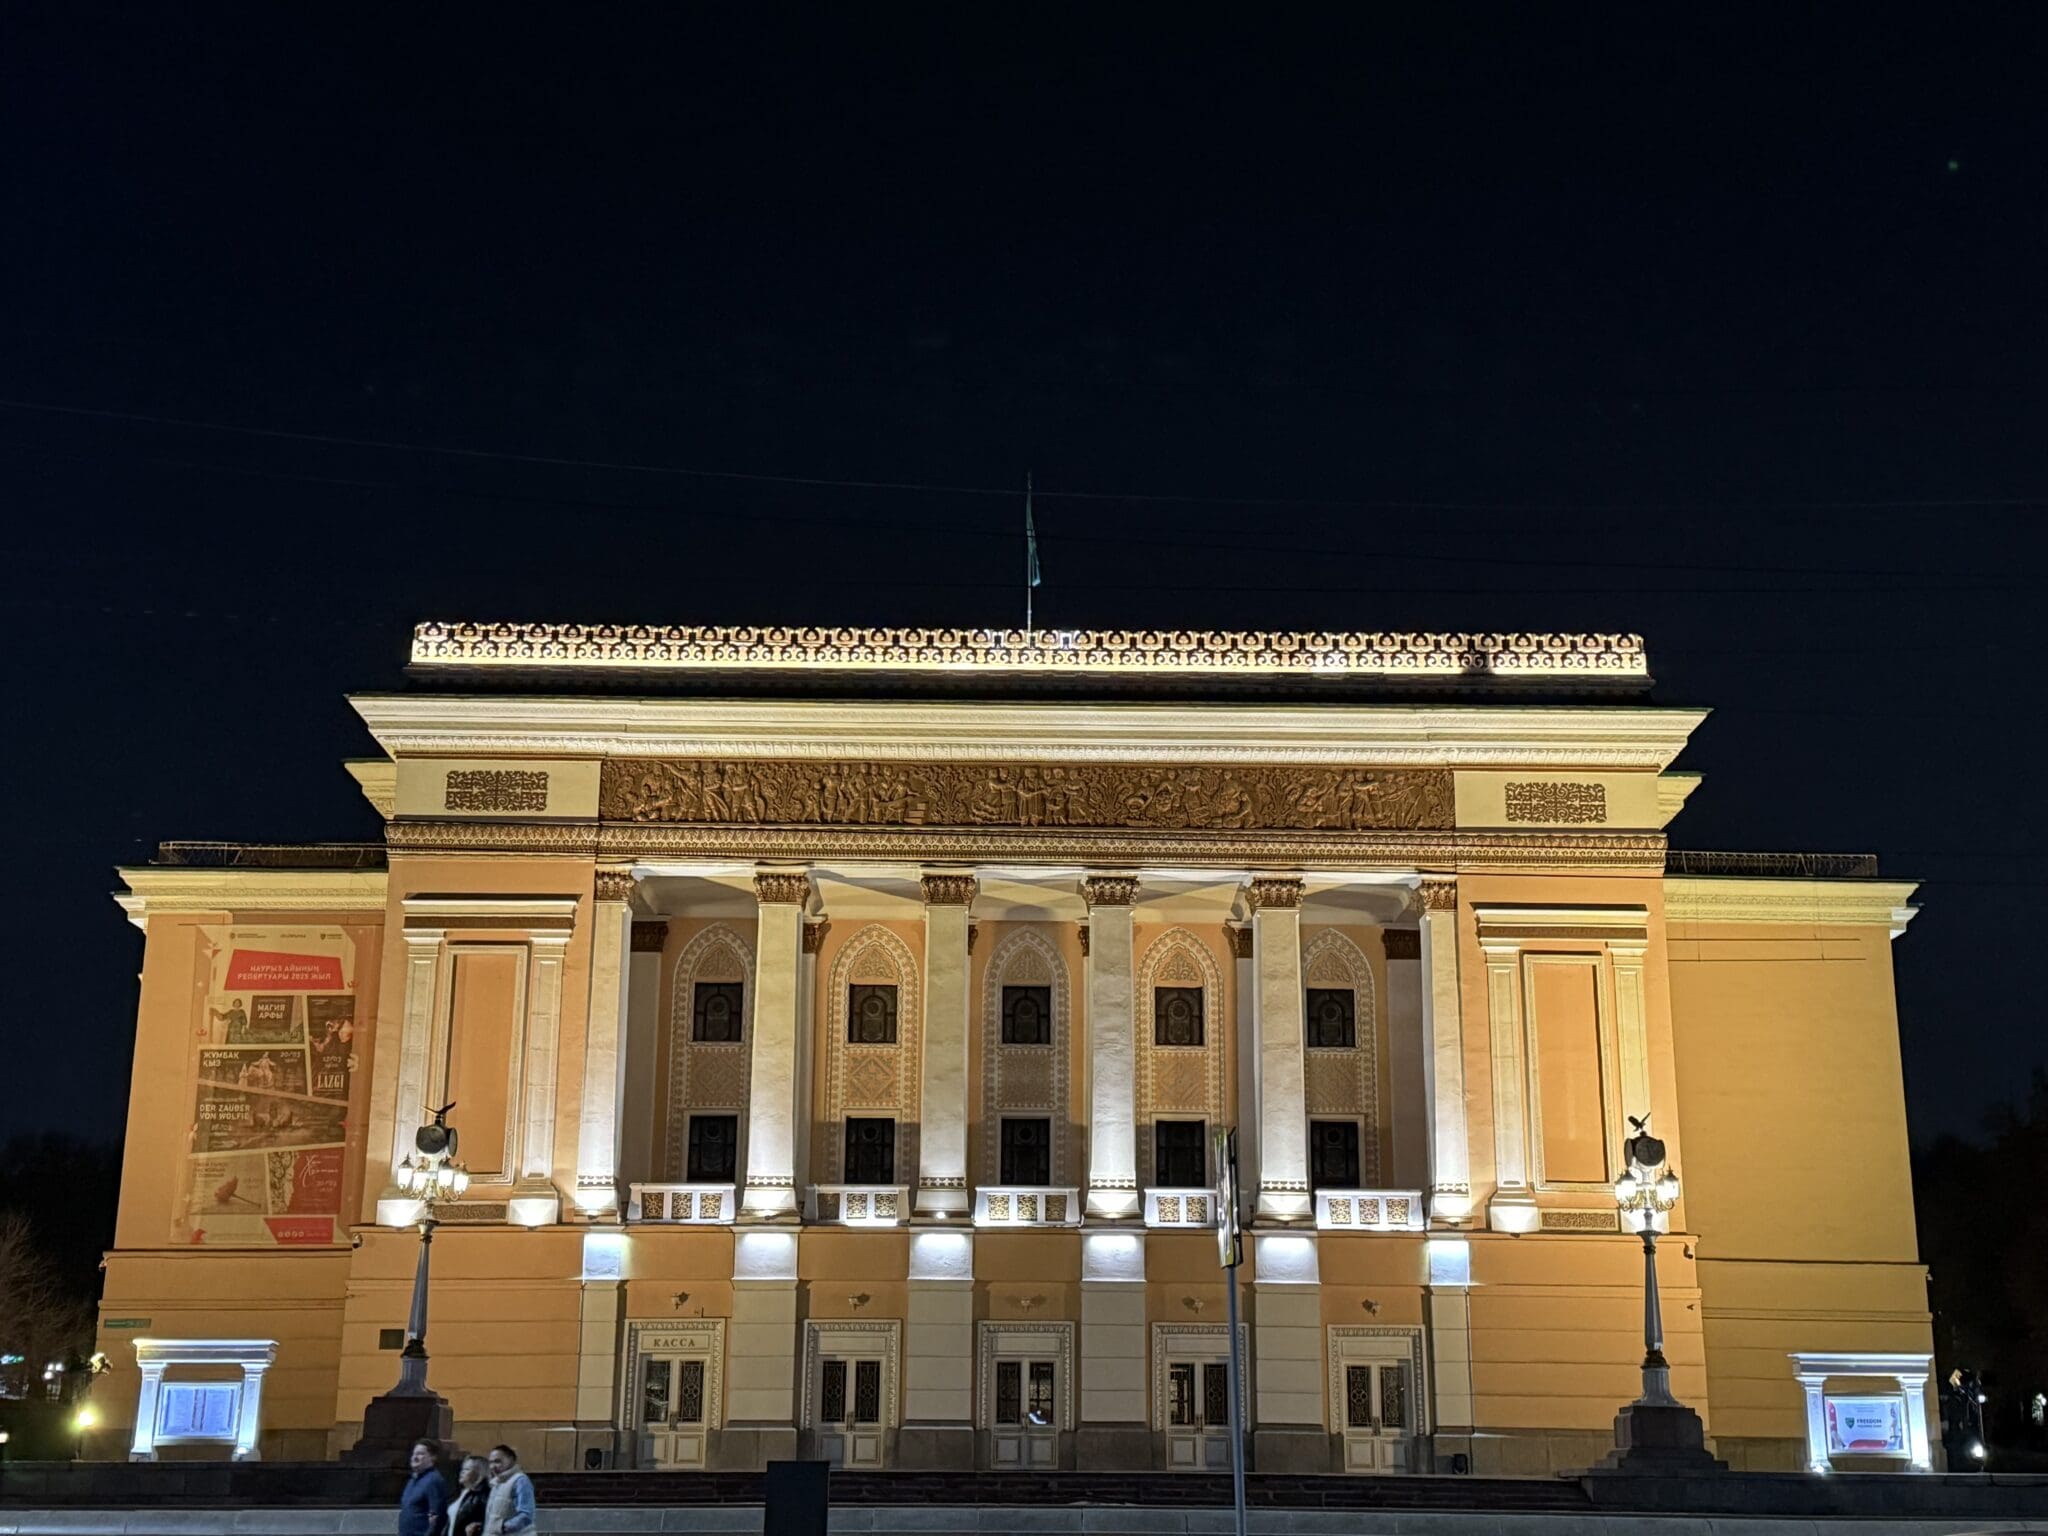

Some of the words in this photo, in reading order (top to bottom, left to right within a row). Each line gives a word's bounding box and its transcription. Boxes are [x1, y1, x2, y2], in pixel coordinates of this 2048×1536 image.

[257, 1004, 286, 1012] МАГИЯ
[317, 1074, 344, 1088] LAZGI
[200, 1104, 216, 1112] DER
[218, 1104, 251, 1112] ZAUBER
[200, 1112, 217, 1120] VON
[218, 1112, 249, 1120] WOLFIE
[653, 1338, 695, 1347] КАССА
